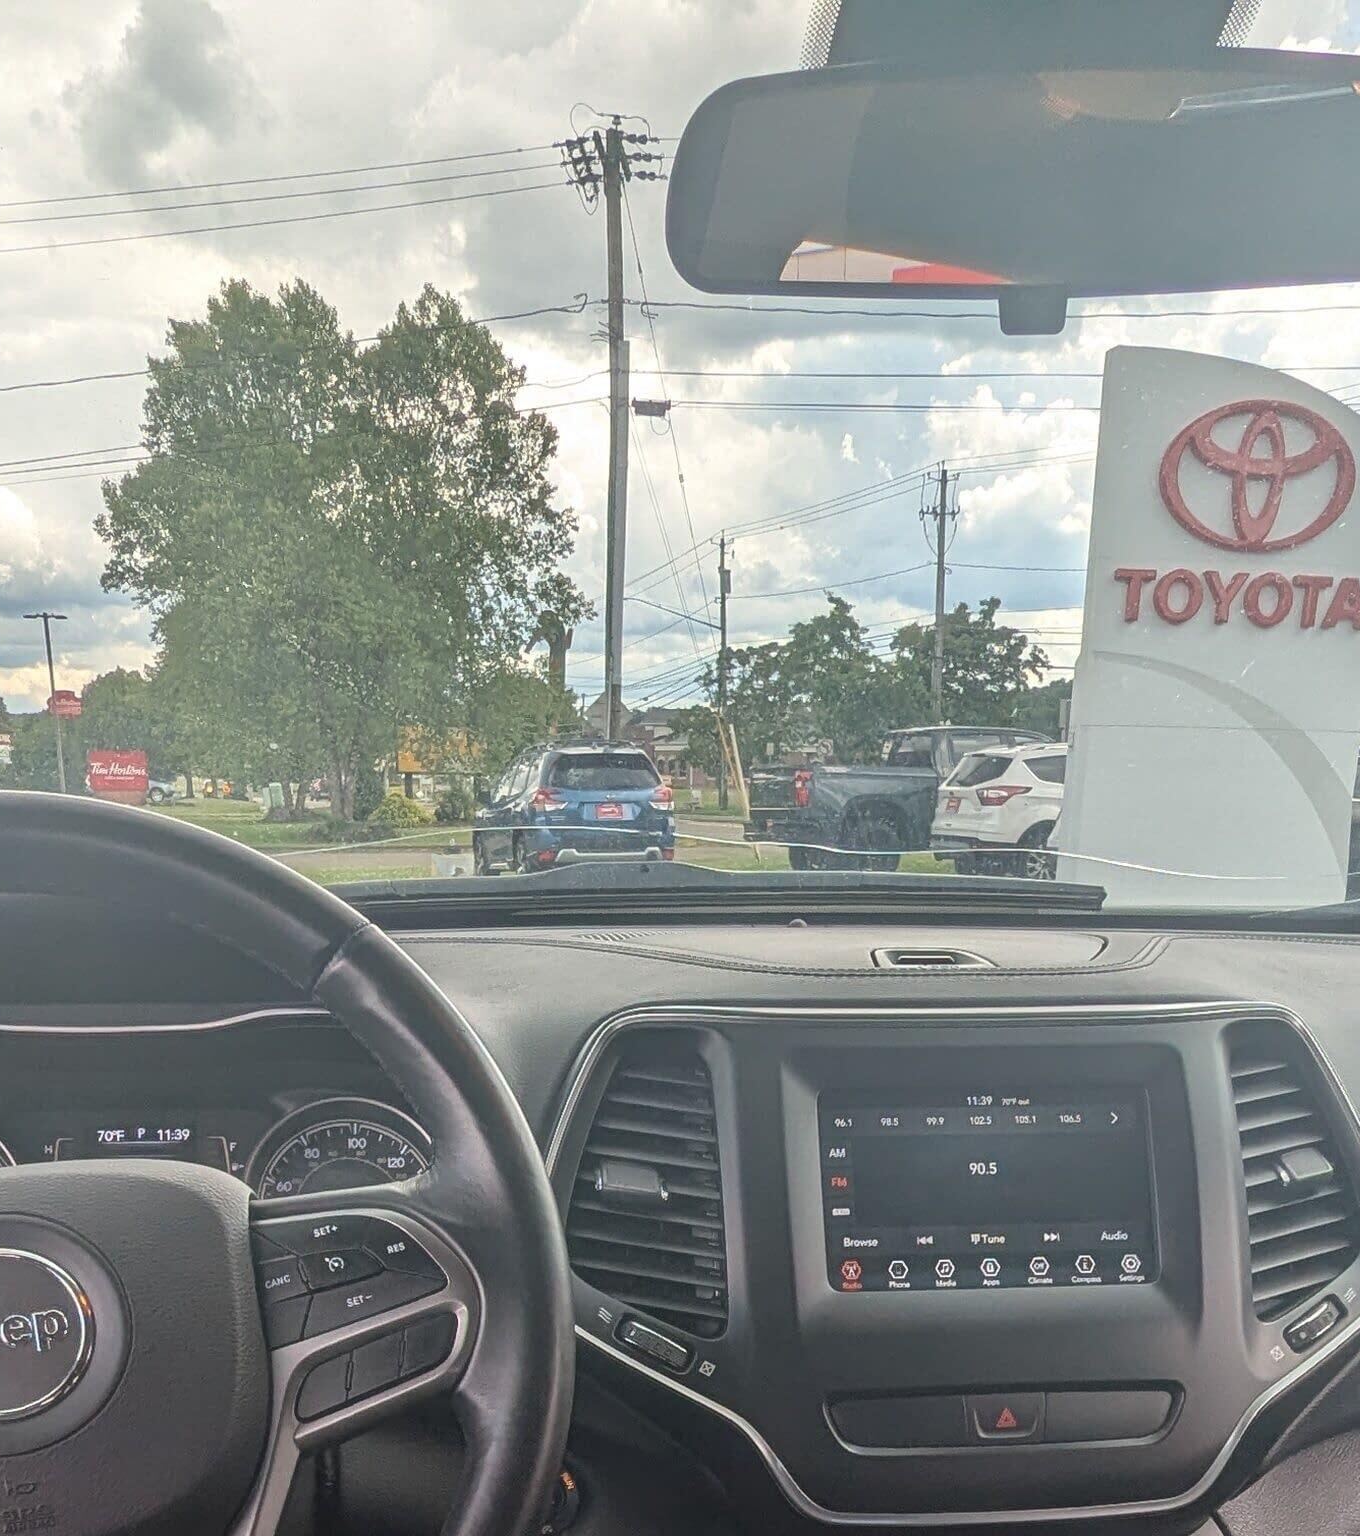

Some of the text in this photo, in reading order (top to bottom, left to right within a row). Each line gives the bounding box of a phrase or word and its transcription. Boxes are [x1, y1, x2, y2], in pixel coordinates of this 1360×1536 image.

[91, 763, 108, 775] Tim
[966, 1096, 992, 1105] 11:39
[834, 1118, 852, 1127] 96.1
[881, 1117, 899, 1126] 98.5
[927, 1117, 944, 1126] 99.9
[970, 1116, 992, 1125] 102.5
[1059, 1114, 1081, 1123] 106.5
[138, 1128, 145, 1138] P
[157, 1129, 190, 1141] 11:39
[230, 1143, 237, 1151] F
[348, 1138, 367, 1149] 100
[44, 1145, 53, 1154] H
[304, 1148, 320, 1158] 80
[829, 1148, 846, 1158] AM
[387, 1157, 405, 1168] 120
[969, 1162, 997, 1175] 90.5
[276, 1181, 292, 1192] 60
[843, 1231, 1128, 1247] Browse Tune Audio
[387, 1242, 405, 1254] RES
